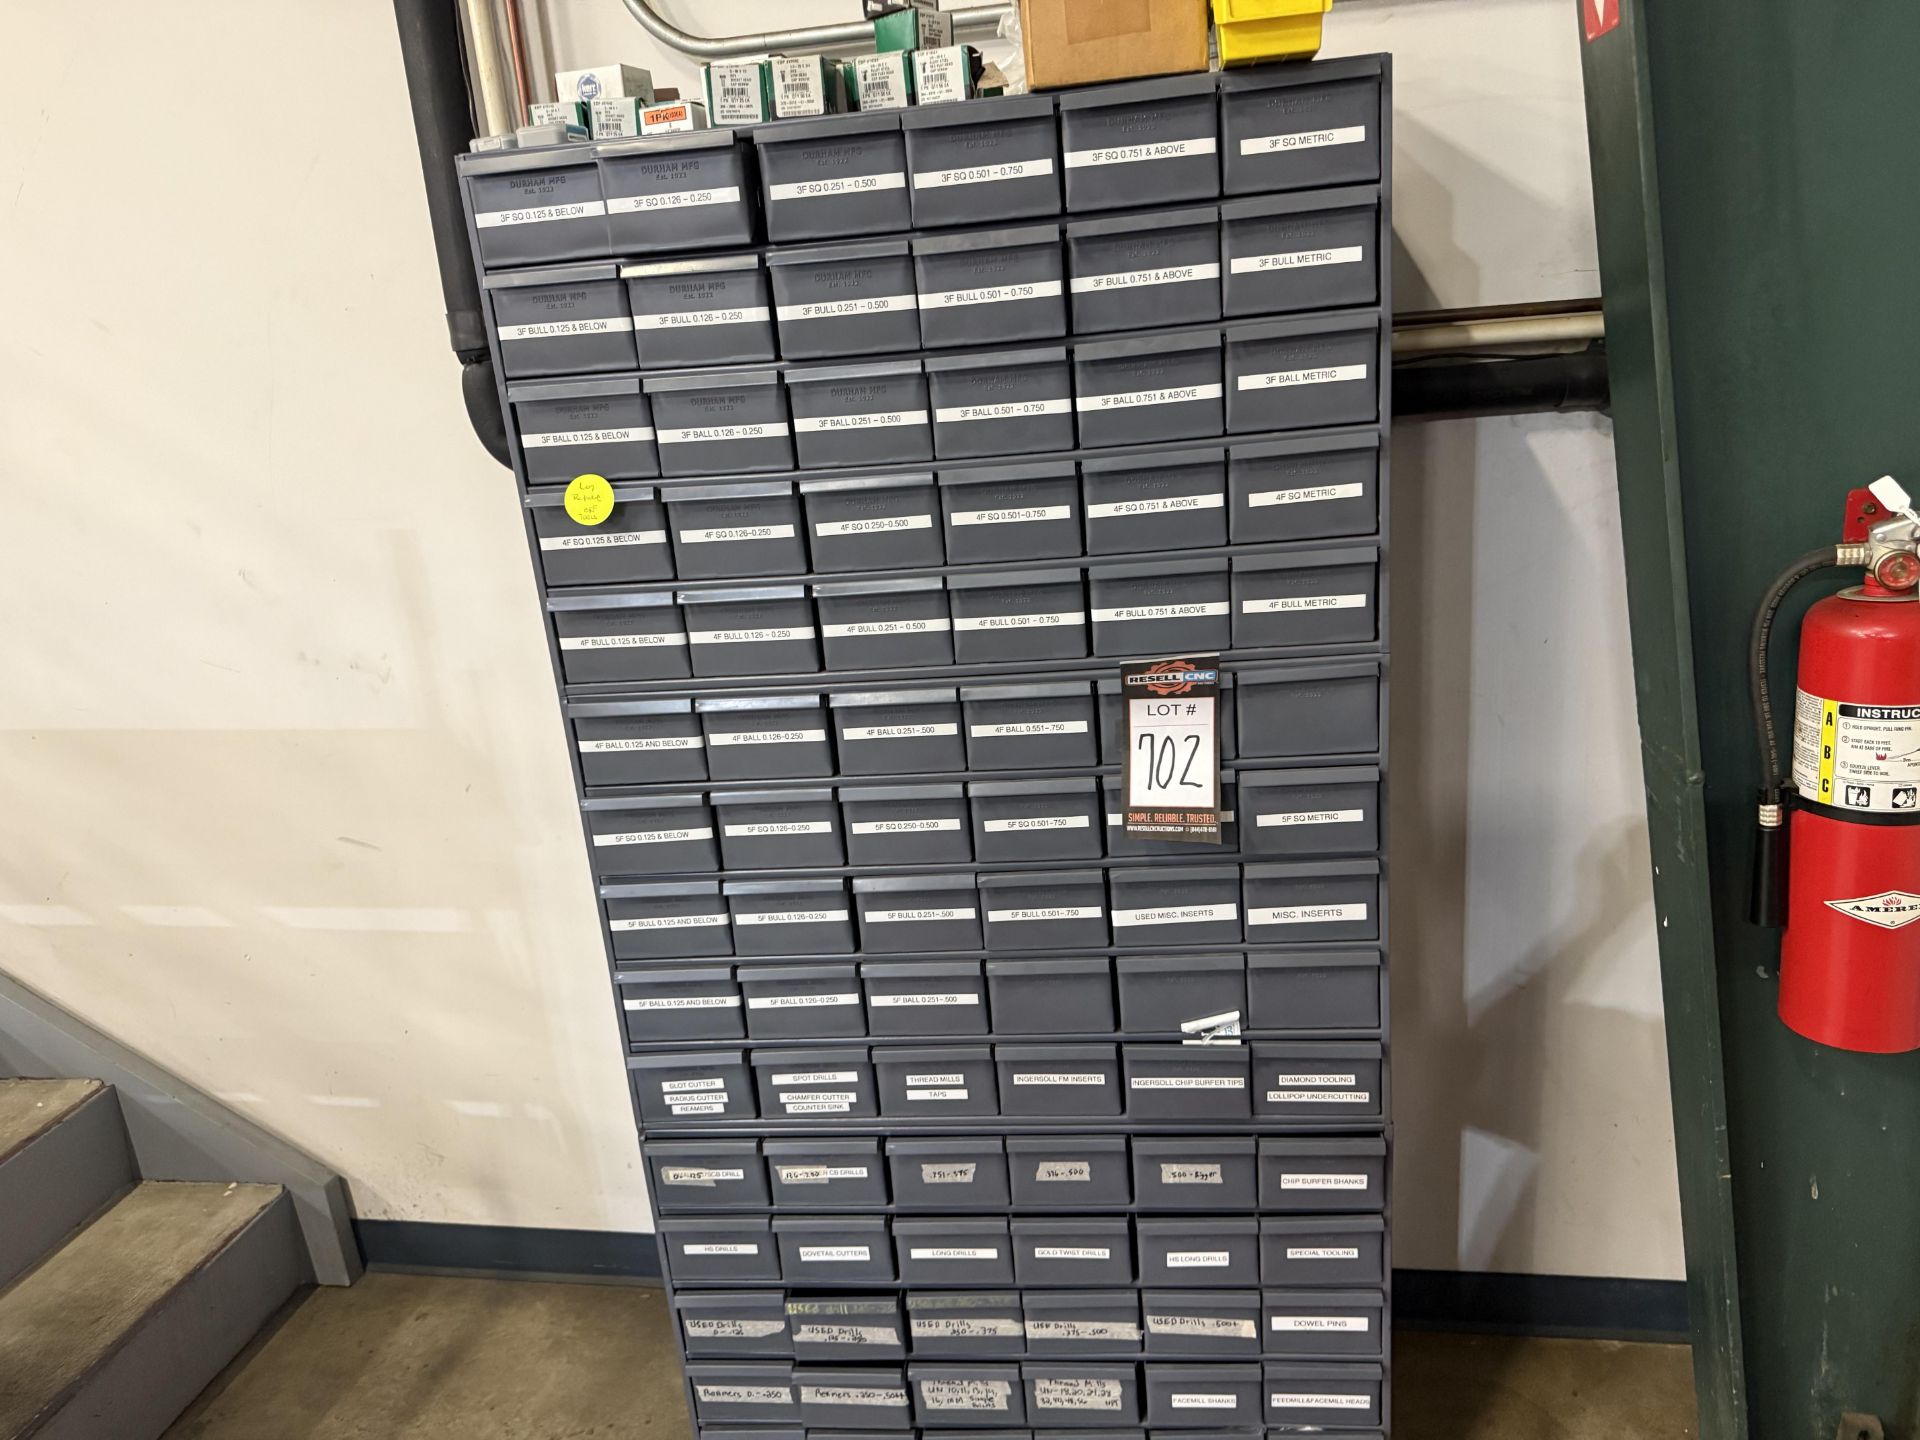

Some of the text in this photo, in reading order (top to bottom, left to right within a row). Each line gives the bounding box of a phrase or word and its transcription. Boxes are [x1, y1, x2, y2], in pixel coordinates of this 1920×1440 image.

[1268, 131, 1334, 149] 3F SQ METRIC
[1091, 143, 1186, 162] 3F SQ 0.751 & ABOVE
[640, 163, 678, 174] DURHAM
[940, 164, 1024, 183] 3F SQ 0.501 0.750
[510, 178, 546, 189] DURHAM
[795, 177, 877, 195] 3F SQ 0.251 0.500
[633, 191, 712, 208] 3F SQ 0.126 0.250
[499, 205, 584, 223] 3F SQ 0.125 & BELOW
[1258, 251, 1332, 268] 3F BULL METRIC
[1092, 267, 1193, 288] 3F BULL 0.751 & ABOVE
[943, 285, 1034, 304] 3F BULL 0.501 0.750
[801, 299, 889, 316] 3F BULL 0.251 0.500
[658, 310, 743, 325] 3F BULL 0.126 0.250
[516, 320, 607, 336] 3F BULL 0.125 & BELOW
[1264, 369, 1337, 385] 3F BALL METRIC
[1100, 388, 1197, 406] 3F BALL 0.751 & ABOVE
[959, 402, 1045, 418] 3F BALL 0.501 0.750
[540, 430, 630, 444] 3F BALL 0.125 & BELOW
[1274, 487, 1336, 501] 4F SQ METRIC
[1112, 497, 1198, 513] 4F SQ 0.751 & ABOVE
[975, 508, 1046, 521] 4F SQ 0.501-0.750
[1268, 597, 1337, 608] 4F BULL METRIC
[1113, 605, 1206, 618] 4F BULL 0.751 & ABOVE
[1129, 672, 1216, 684] RESELL CNC
[1147, 704, 1196, 716] LOT #
[1857, 708, 1920, 719] INSTRUC
[1826, 712, 1832, 726] A
[1824, 745, 1831, 759] B
[1138, 733, 1204, 790] 702
[1822, 778, 1829, 792] C
[1128, 813, 1217, 823] SIMPLE. RELIABLE. TRUSTED.
[1281, 812, 1339, 823] 5F SQ METRIC
[1134, 908, 1214, 921] USED MISC. INSERTS
[1271, 908, 1342, 919] MISC. INSERTS
[1850, 904, 1920, 912] AMERE
